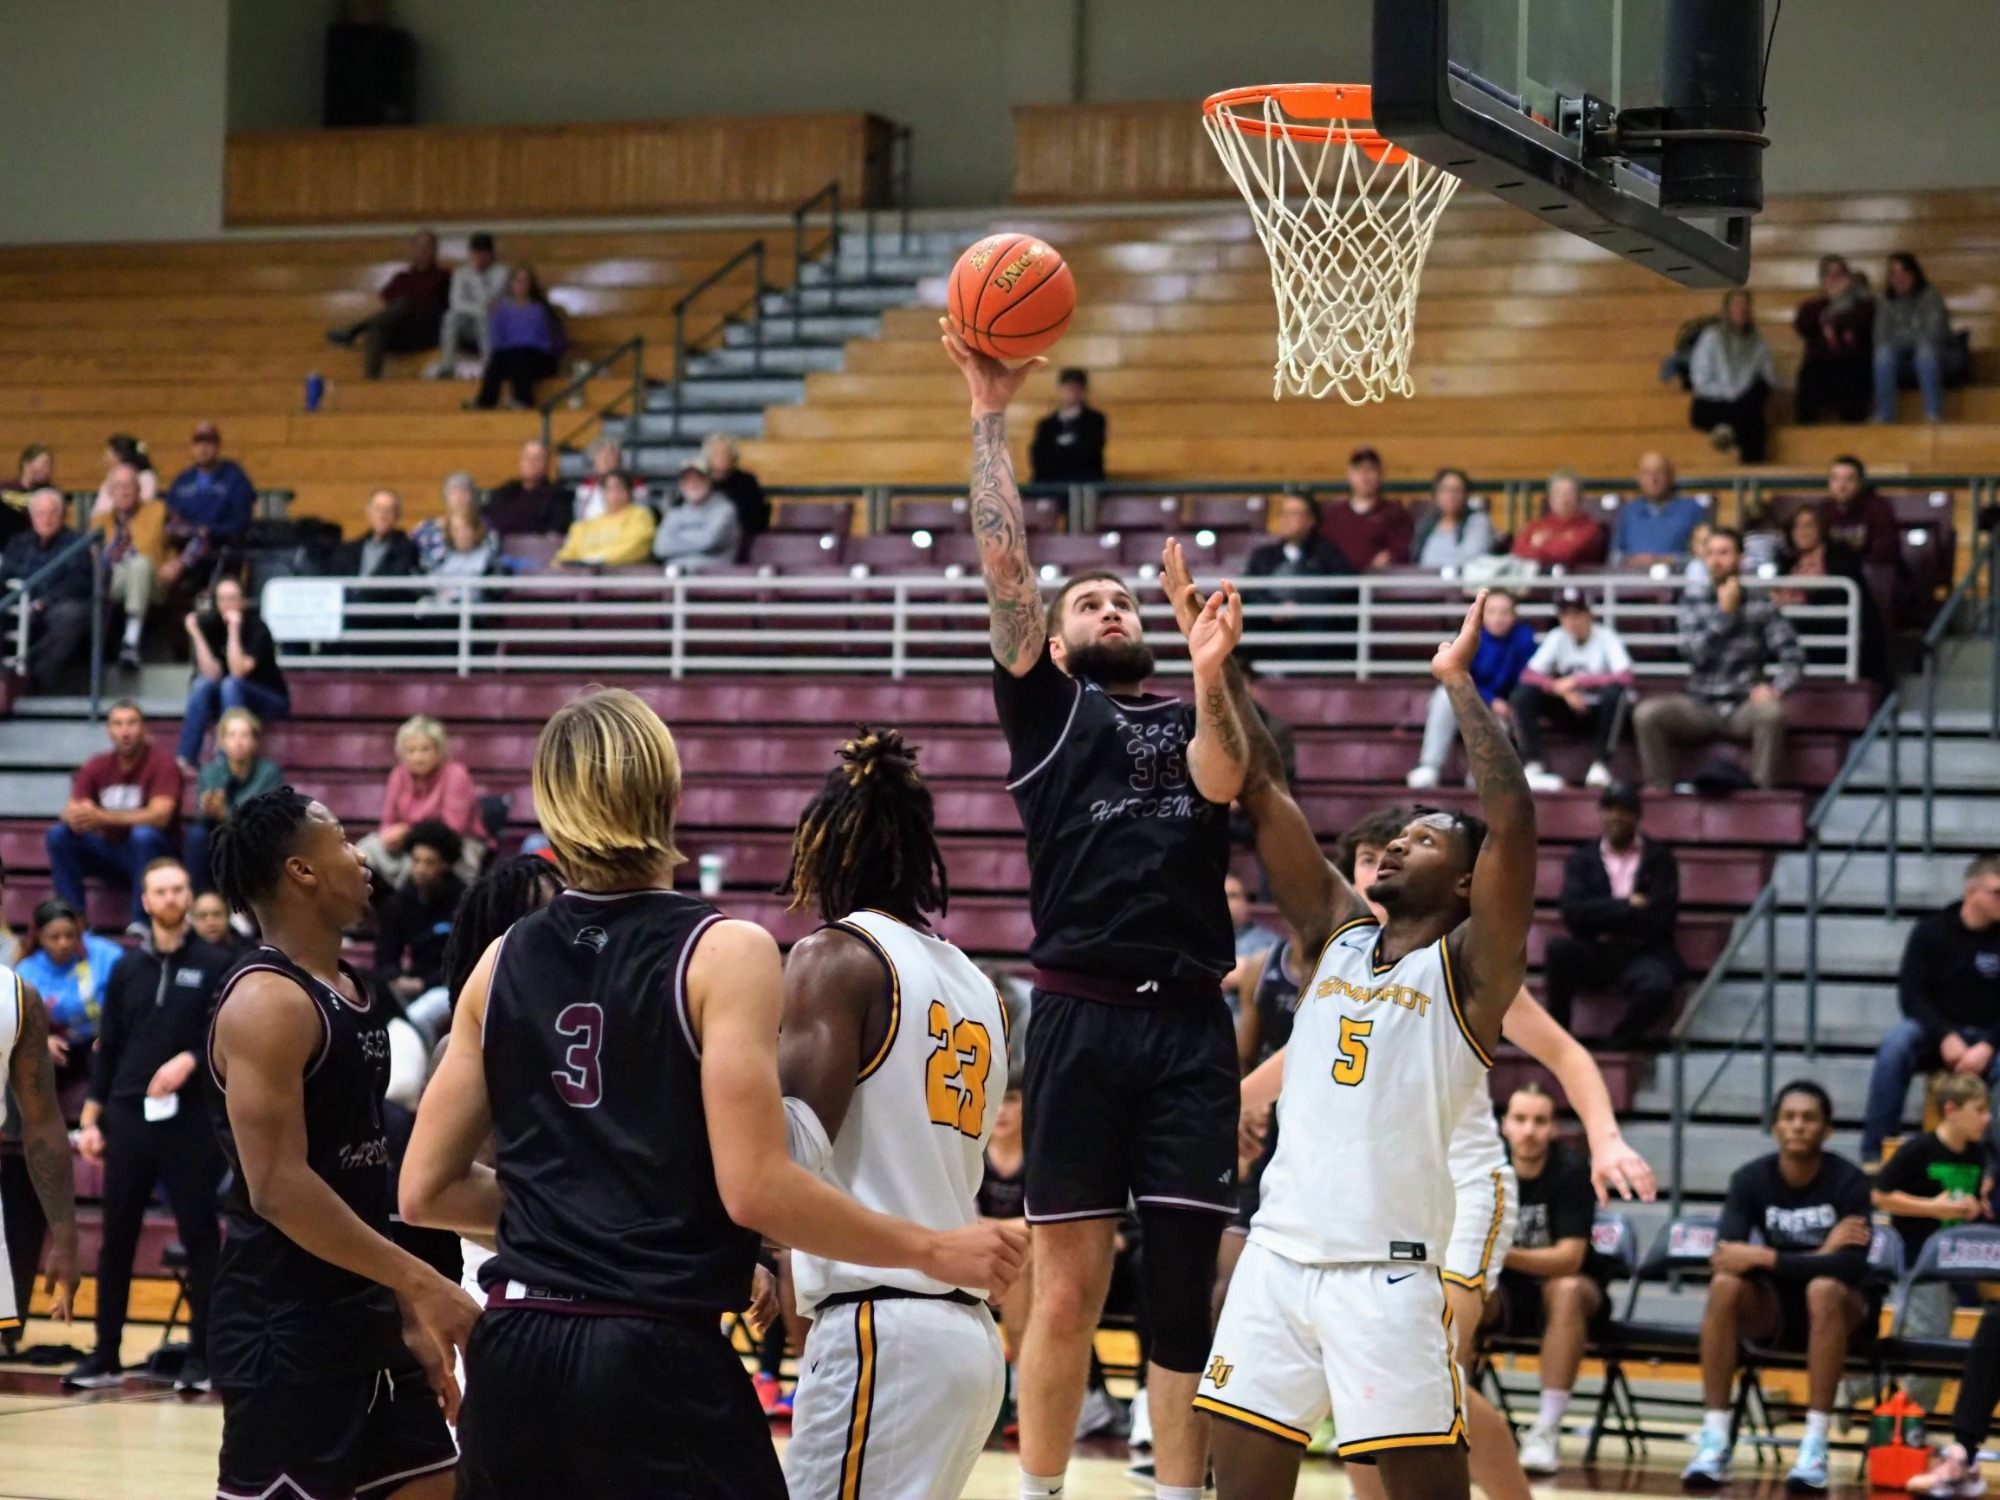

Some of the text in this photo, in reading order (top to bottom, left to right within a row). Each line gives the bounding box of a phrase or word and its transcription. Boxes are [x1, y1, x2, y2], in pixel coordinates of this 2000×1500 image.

[1127, 738, 1189, 792] 33
[551, 1002, 604, 1109] 3
[925, 999, 992, 1140] 23
[1332, 1015, 1374, 1087] 5
